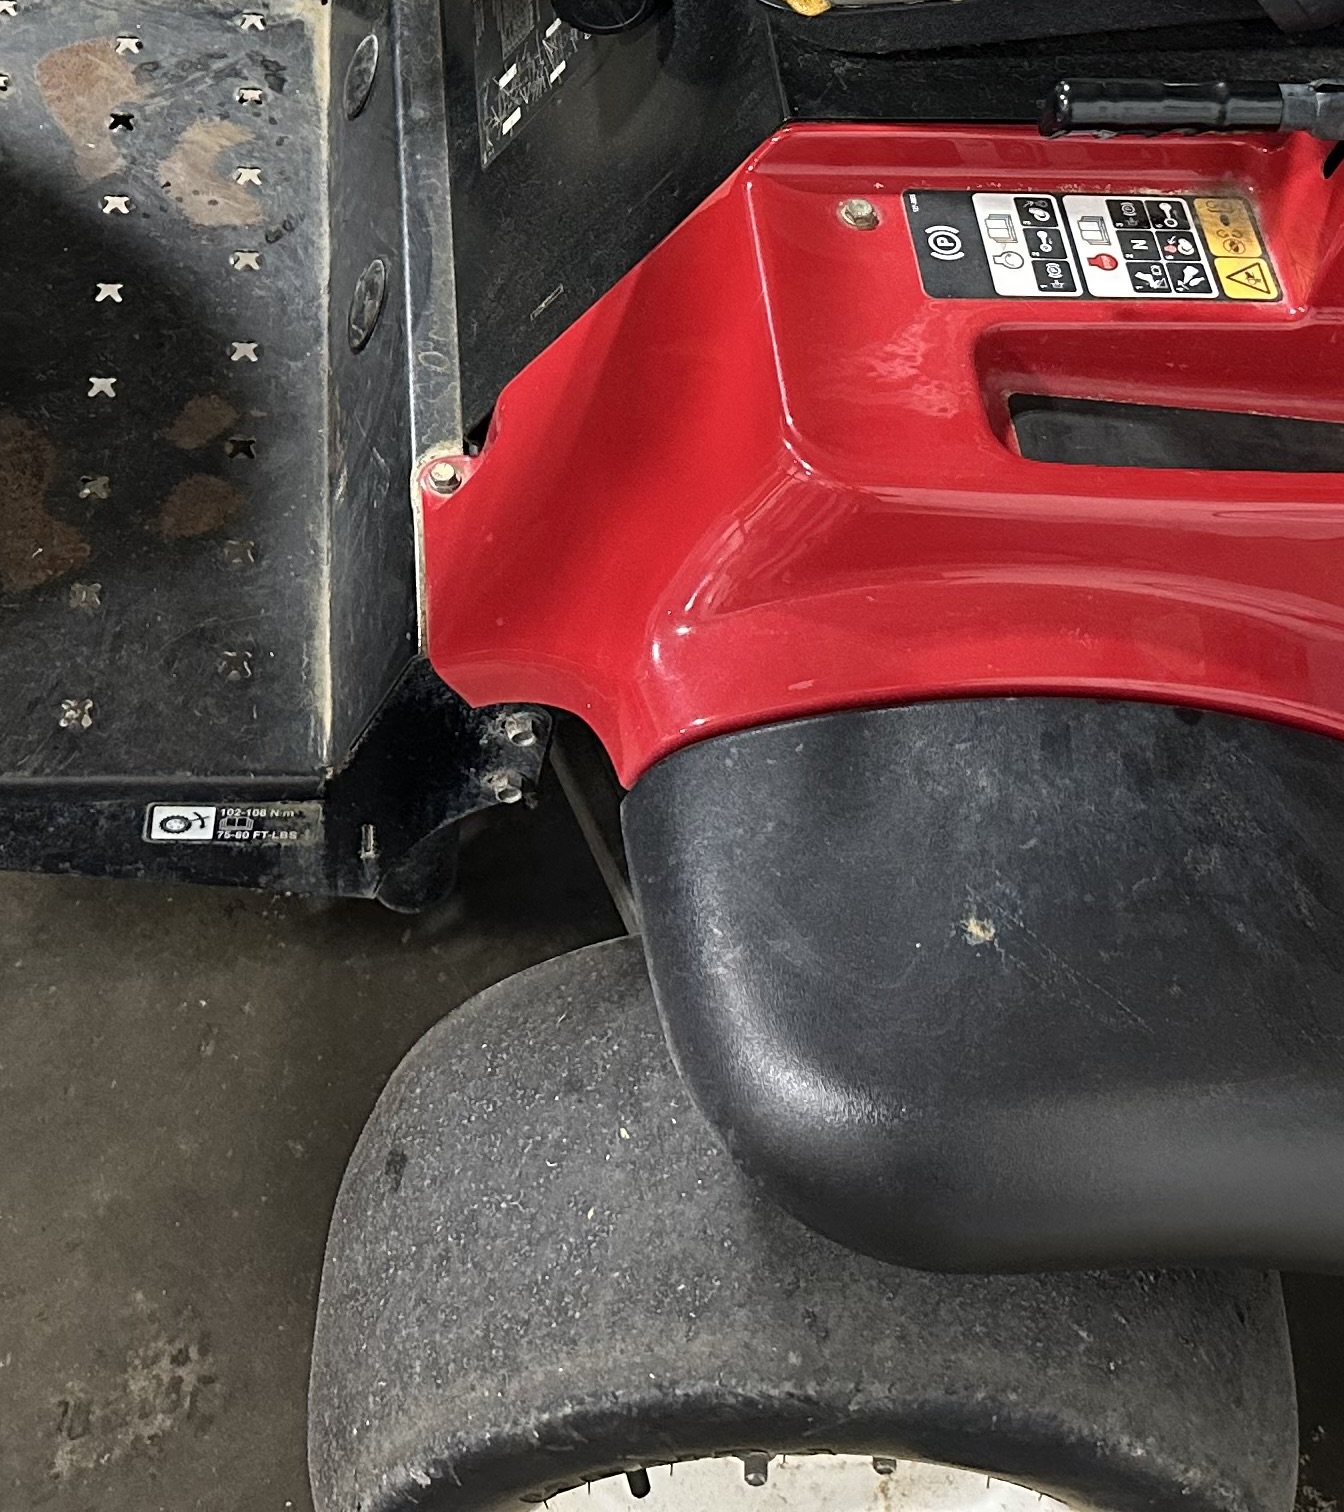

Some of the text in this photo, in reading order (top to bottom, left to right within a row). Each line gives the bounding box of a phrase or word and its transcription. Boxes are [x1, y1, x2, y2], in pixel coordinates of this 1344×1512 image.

[1130, 239, 1149, 250] N
[220, 808, 267, 818] 102-108
[252, 830, 298, 840] FT-LBS
